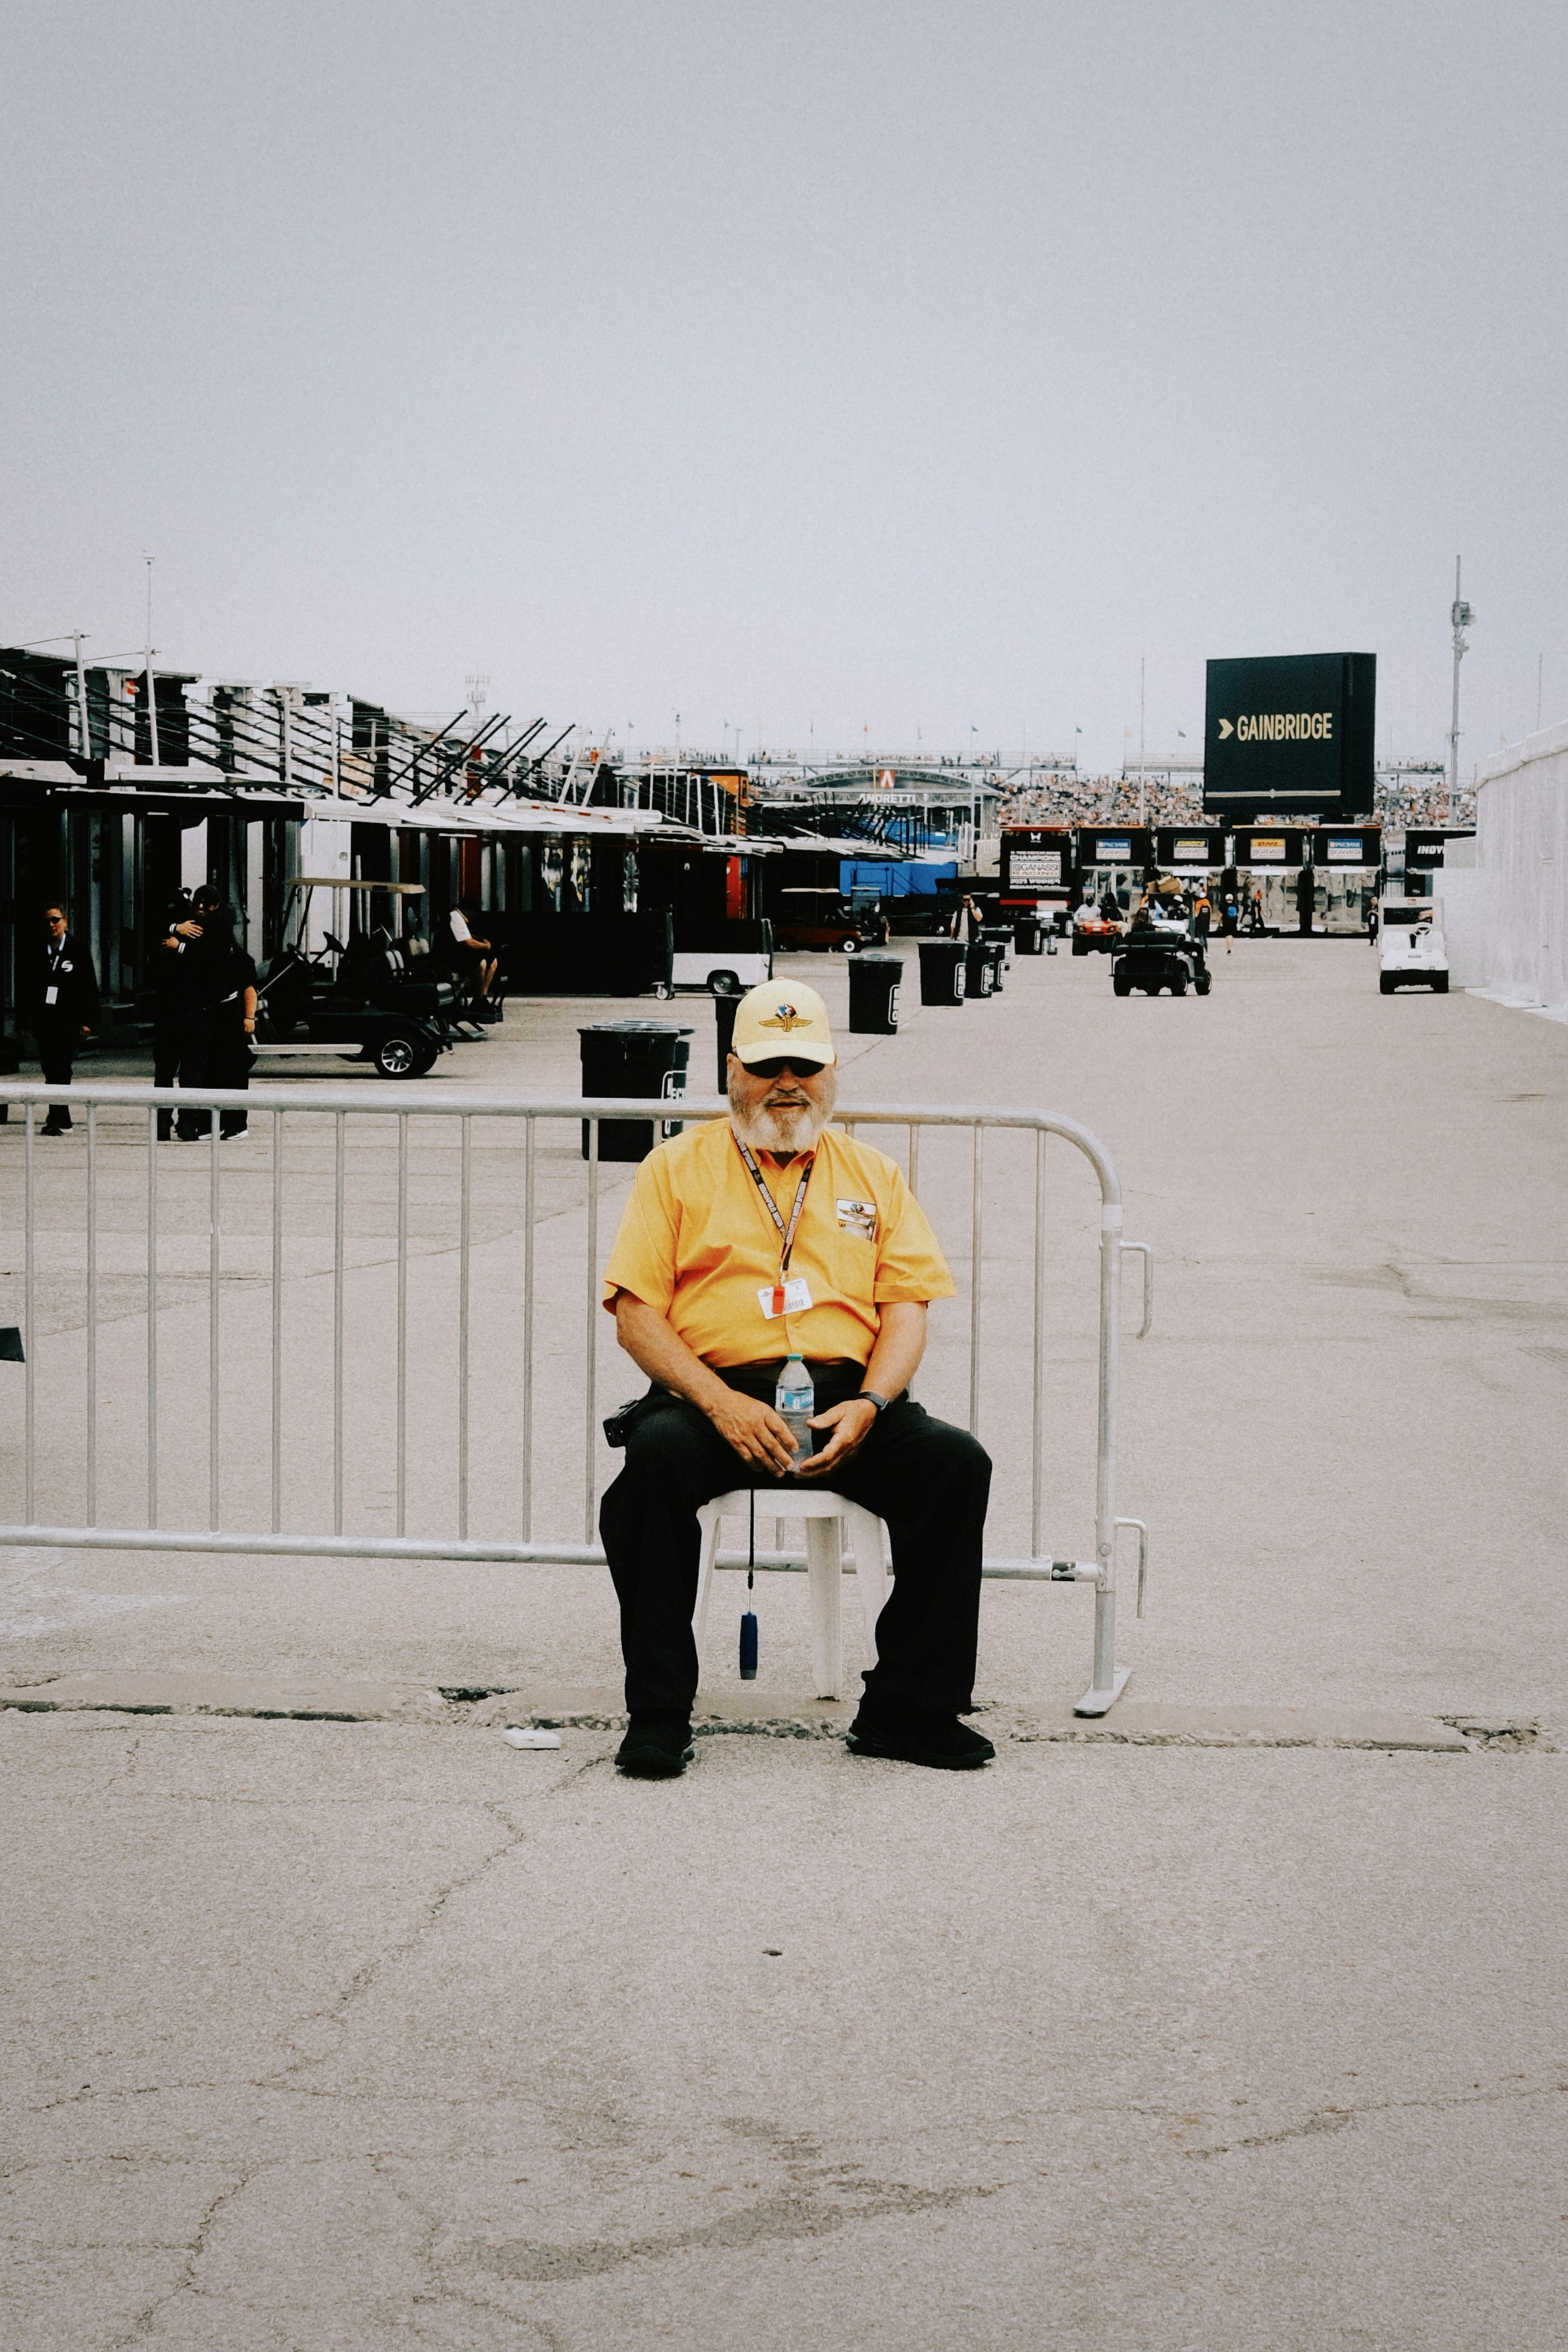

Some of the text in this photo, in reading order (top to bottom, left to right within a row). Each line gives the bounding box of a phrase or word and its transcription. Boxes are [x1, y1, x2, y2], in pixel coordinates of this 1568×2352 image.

[1237, 713, 1333, 741] GAINBRIDGE
[859, 793, 916, 803] ANDRETTI
[1417, 845, 1444, 855] INDY
